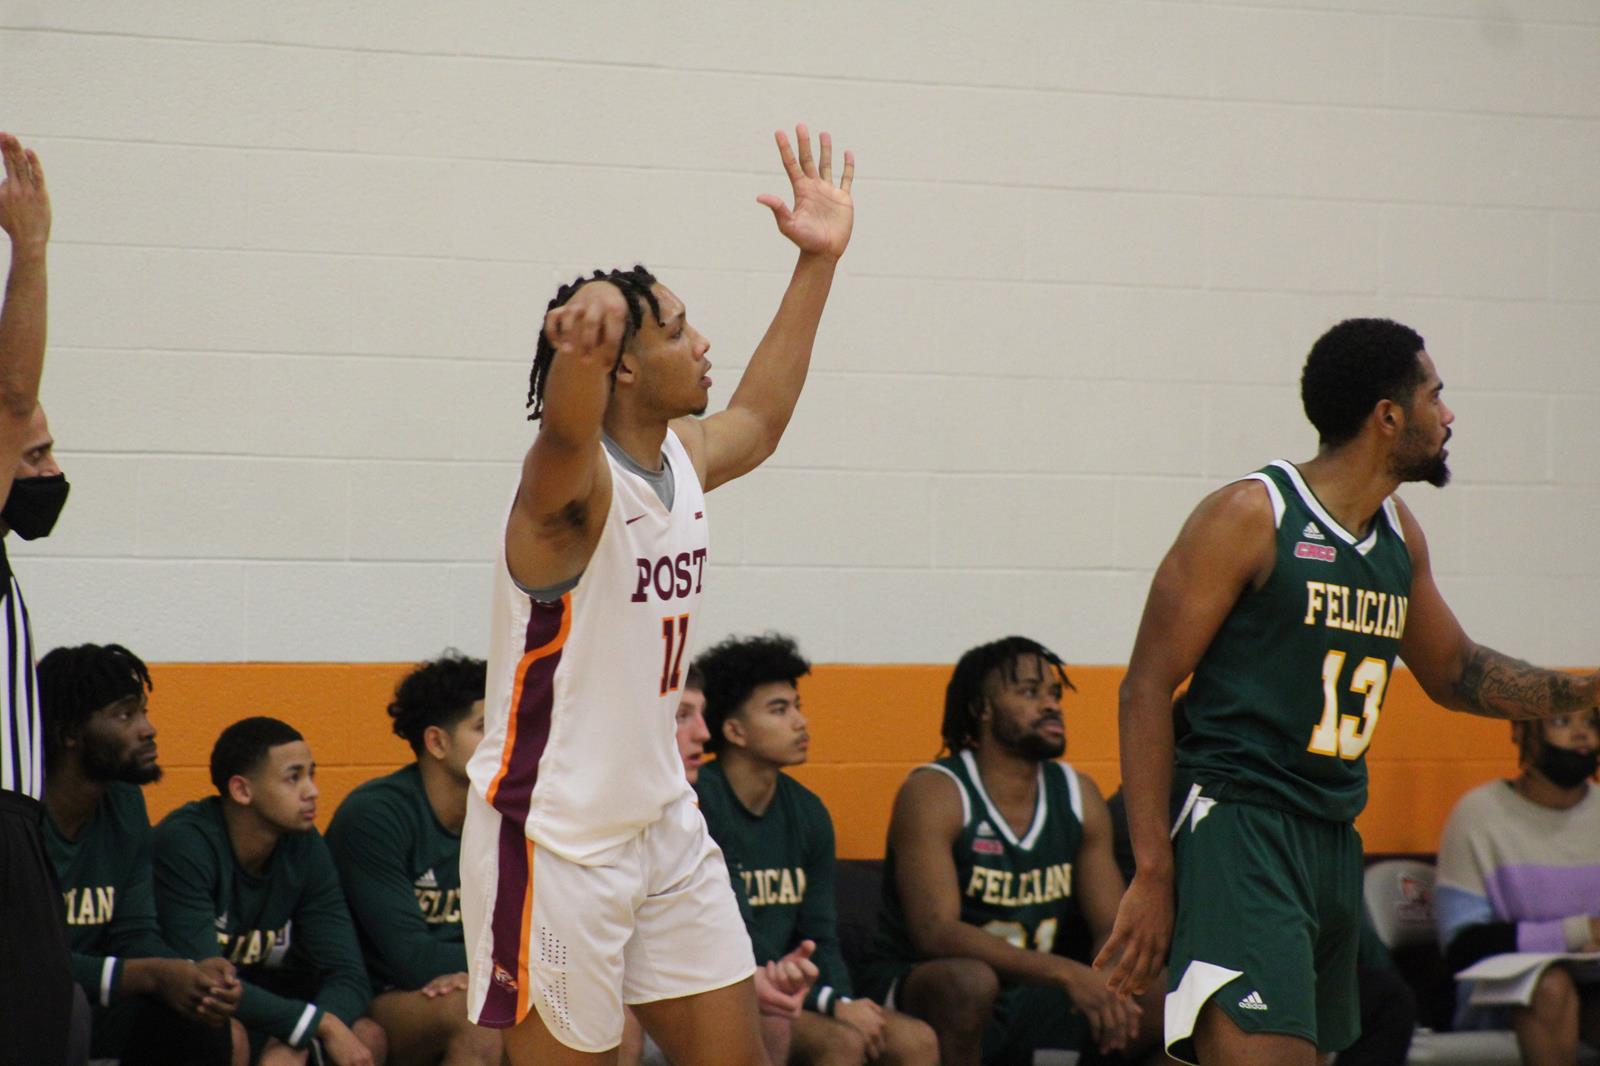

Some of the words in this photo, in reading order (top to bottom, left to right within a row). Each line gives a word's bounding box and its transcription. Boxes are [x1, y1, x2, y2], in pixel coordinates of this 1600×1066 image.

[630, 547, 707, 603] POST
[1304, 580, 1409, 640] FELICIAN
[659, 613, 690, 697] 11
[1306, 649, 1388, 761] 13
